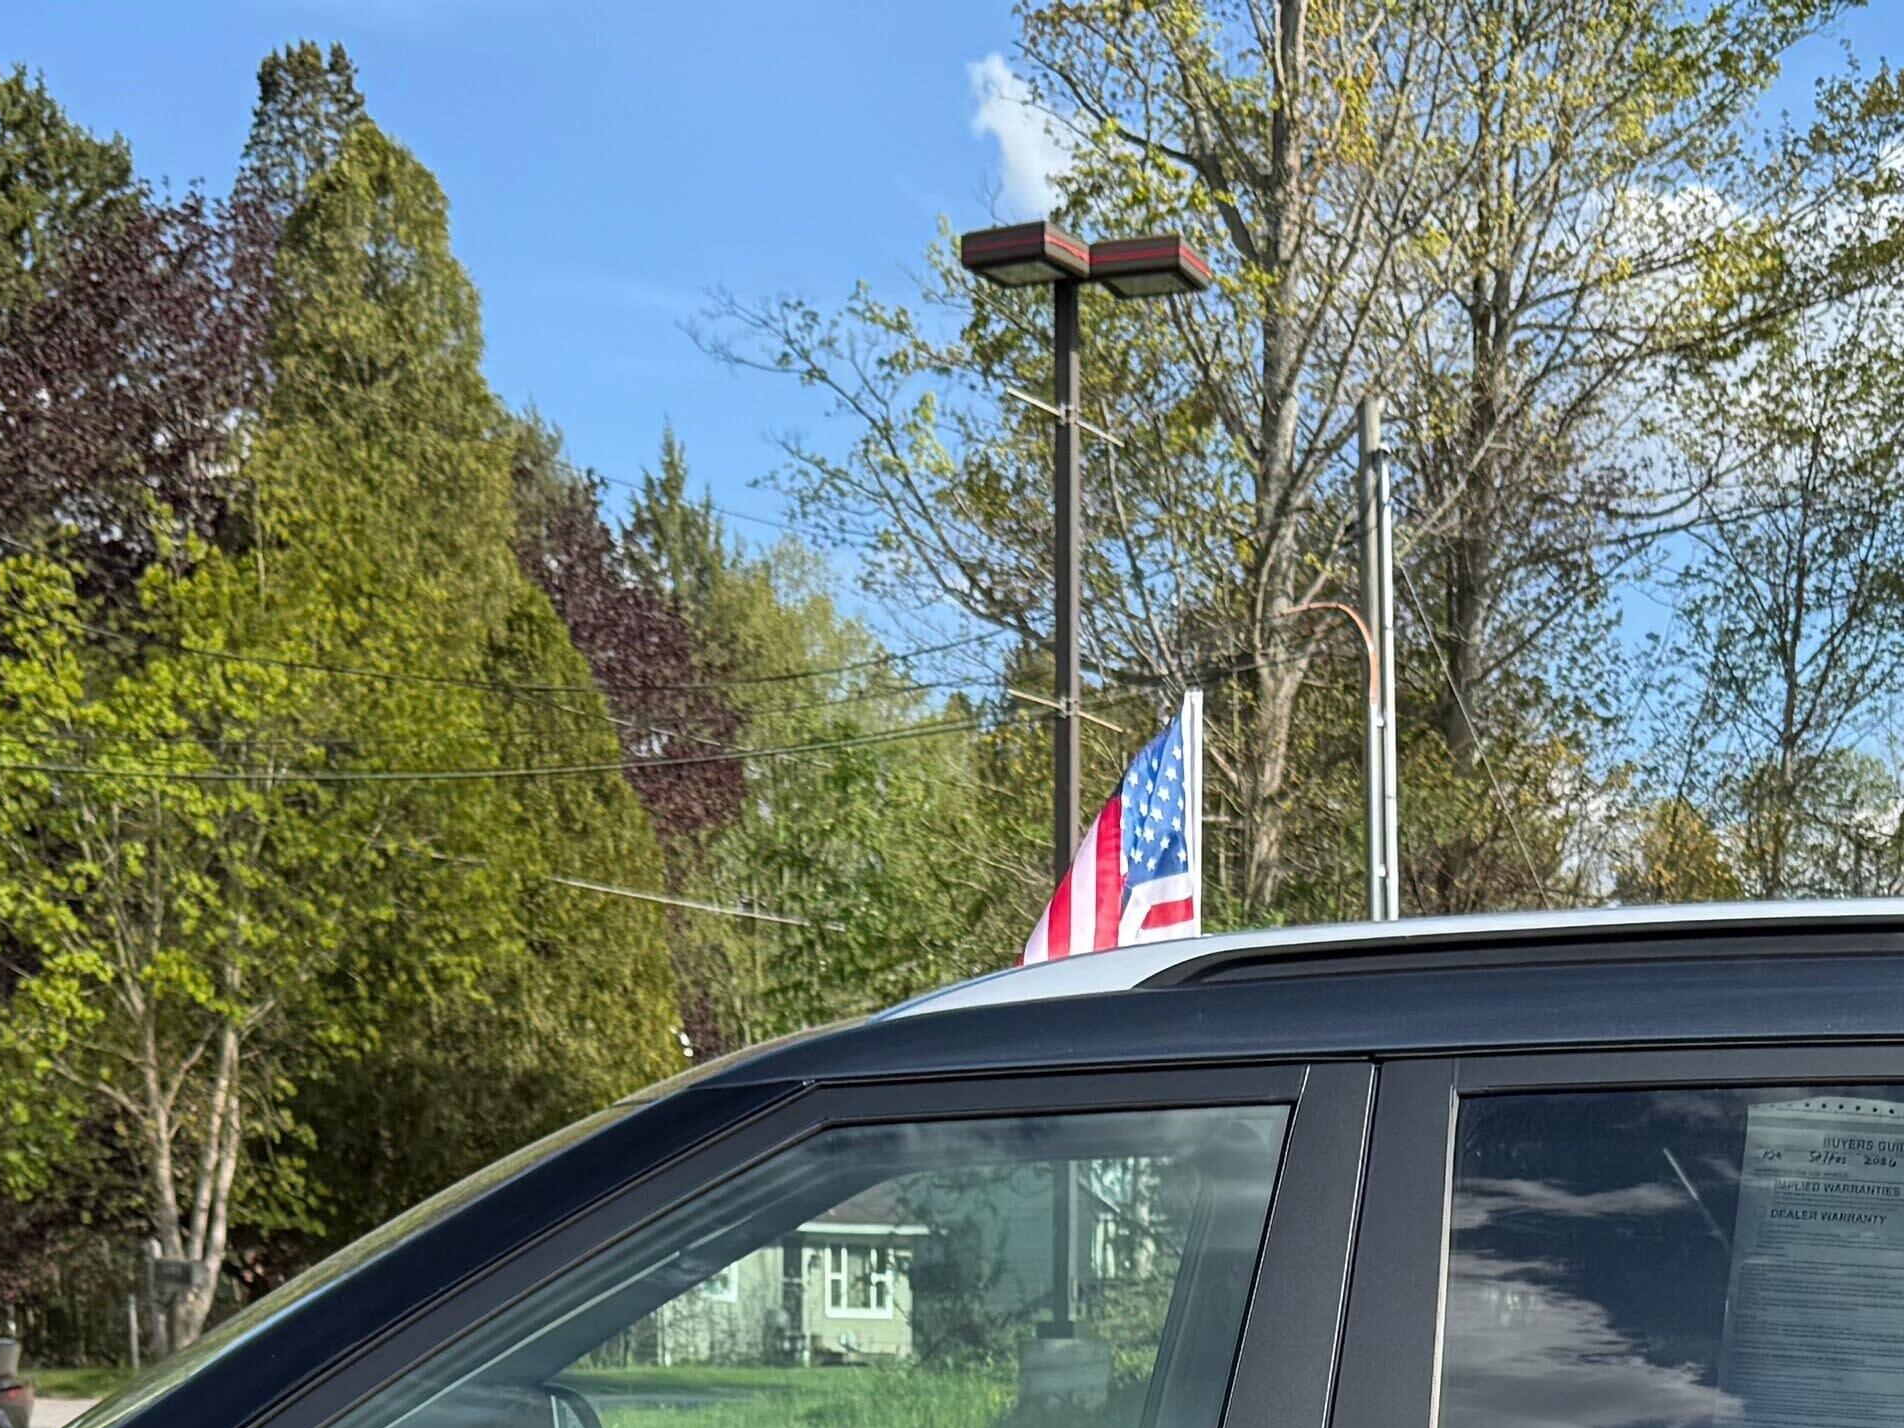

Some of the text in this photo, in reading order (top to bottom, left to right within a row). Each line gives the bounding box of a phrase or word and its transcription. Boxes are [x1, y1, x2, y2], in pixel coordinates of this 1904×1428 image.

[1823, 1136, 1874, 1151] BUYERS
[1824, 1183, 1901, 1198] WARRANTIES
[1770, 1208, 1887, 1225] DEALER WARRANTY
